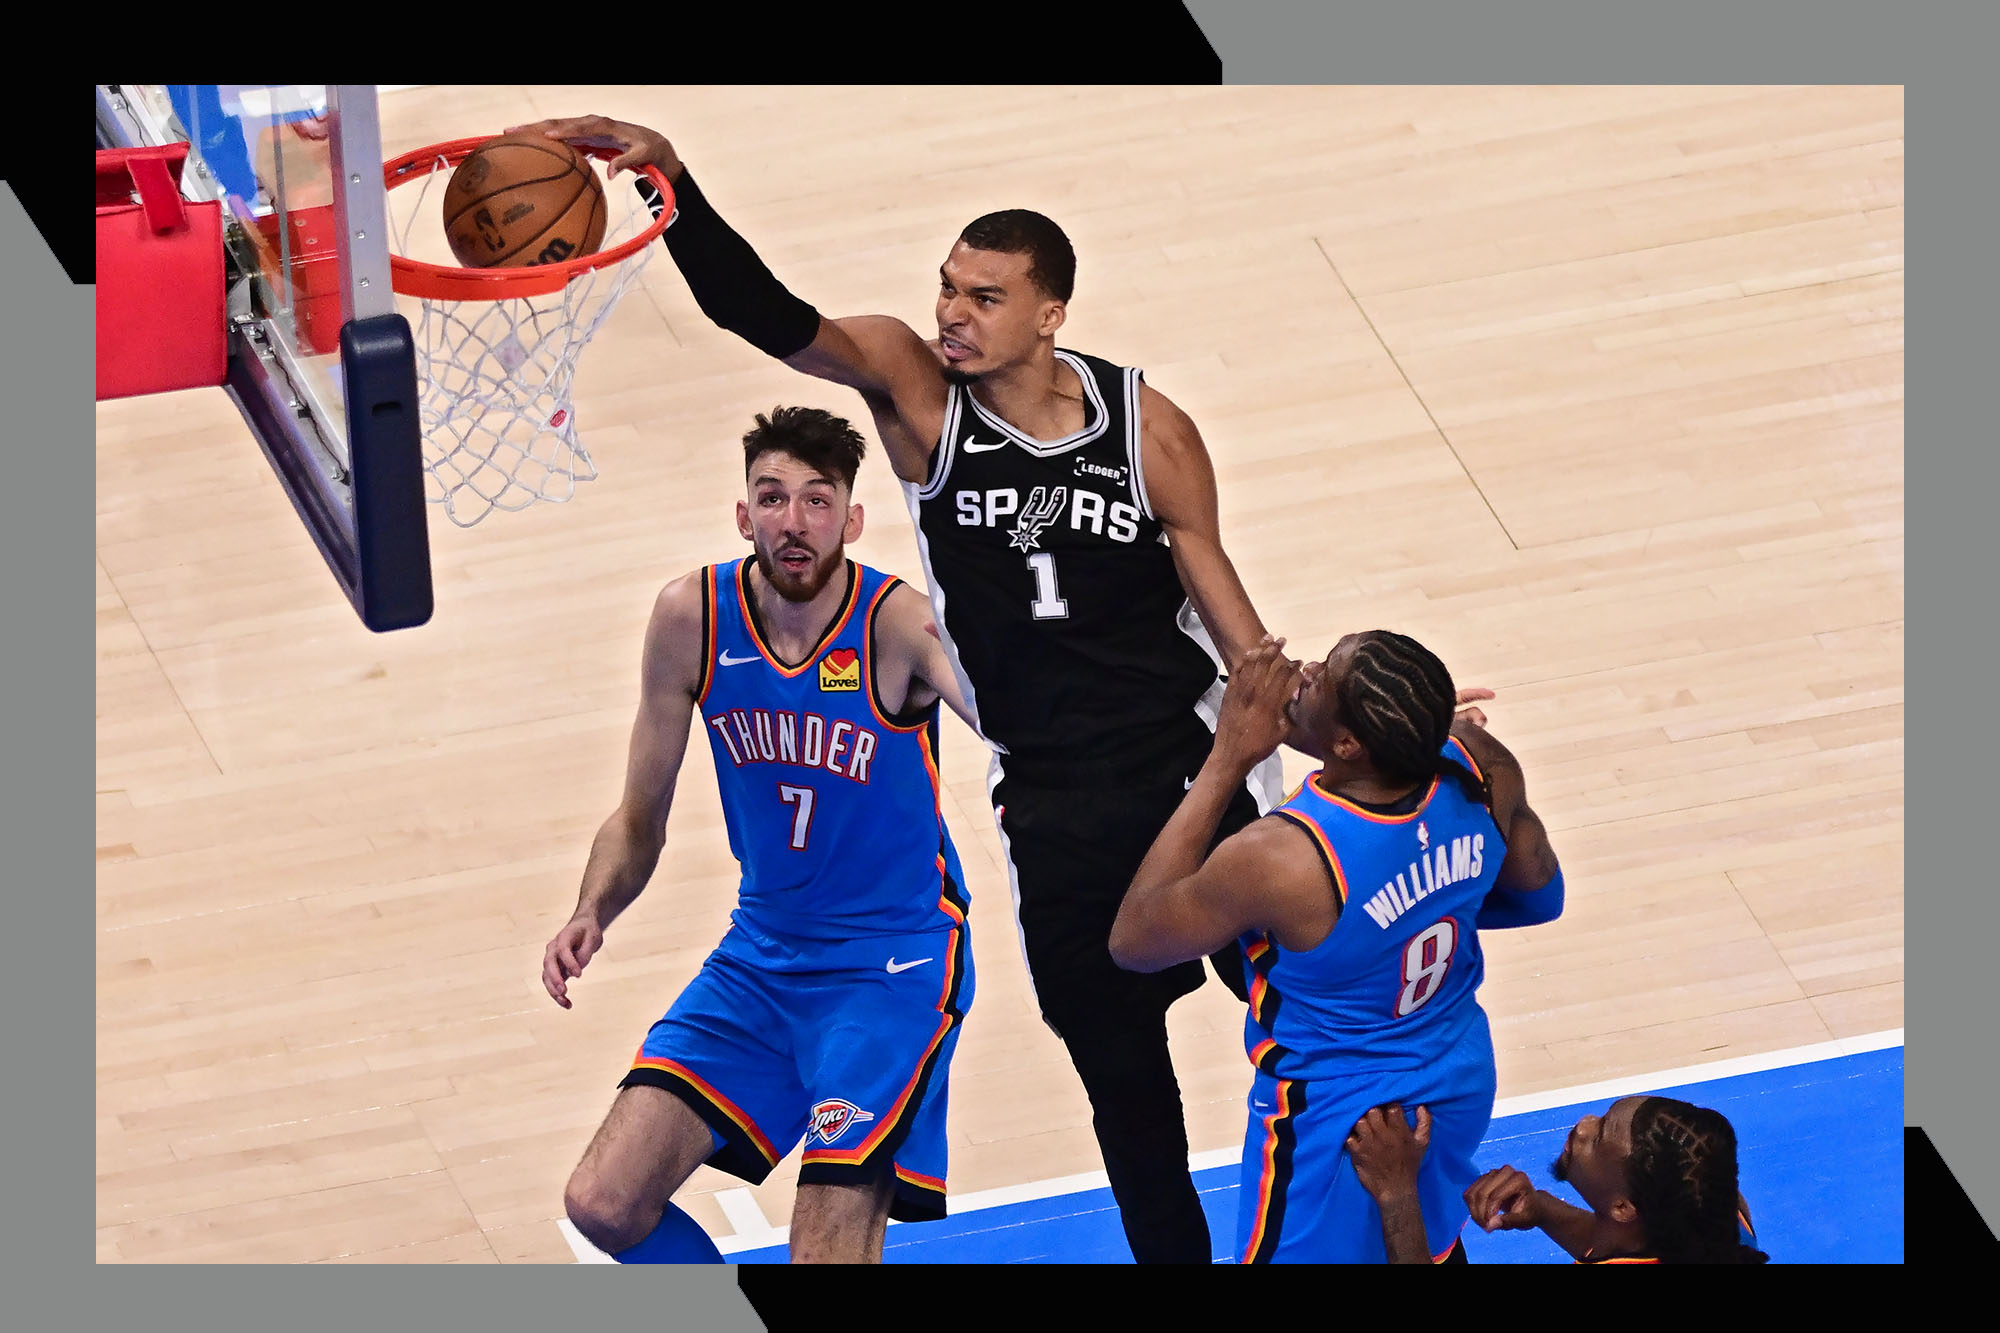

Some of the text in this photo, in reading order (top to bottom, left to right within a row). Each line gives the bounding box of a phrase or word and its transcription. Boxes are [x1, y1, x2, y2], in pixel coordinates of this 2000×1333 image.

[1081, 462, 1120, 480] LEDGER
[956, 486, 1141, 550] SPURS
[1026, 552, 1069, 620] 1
[709, 709, 877, 784] THUNDER
[777, 782, 816, 851] 7
[1363, 833, 1484, 930] WILLIAMS
[1394, 915, 1458, 1019] 8
[812, 1108, 846, 1135] OKC
